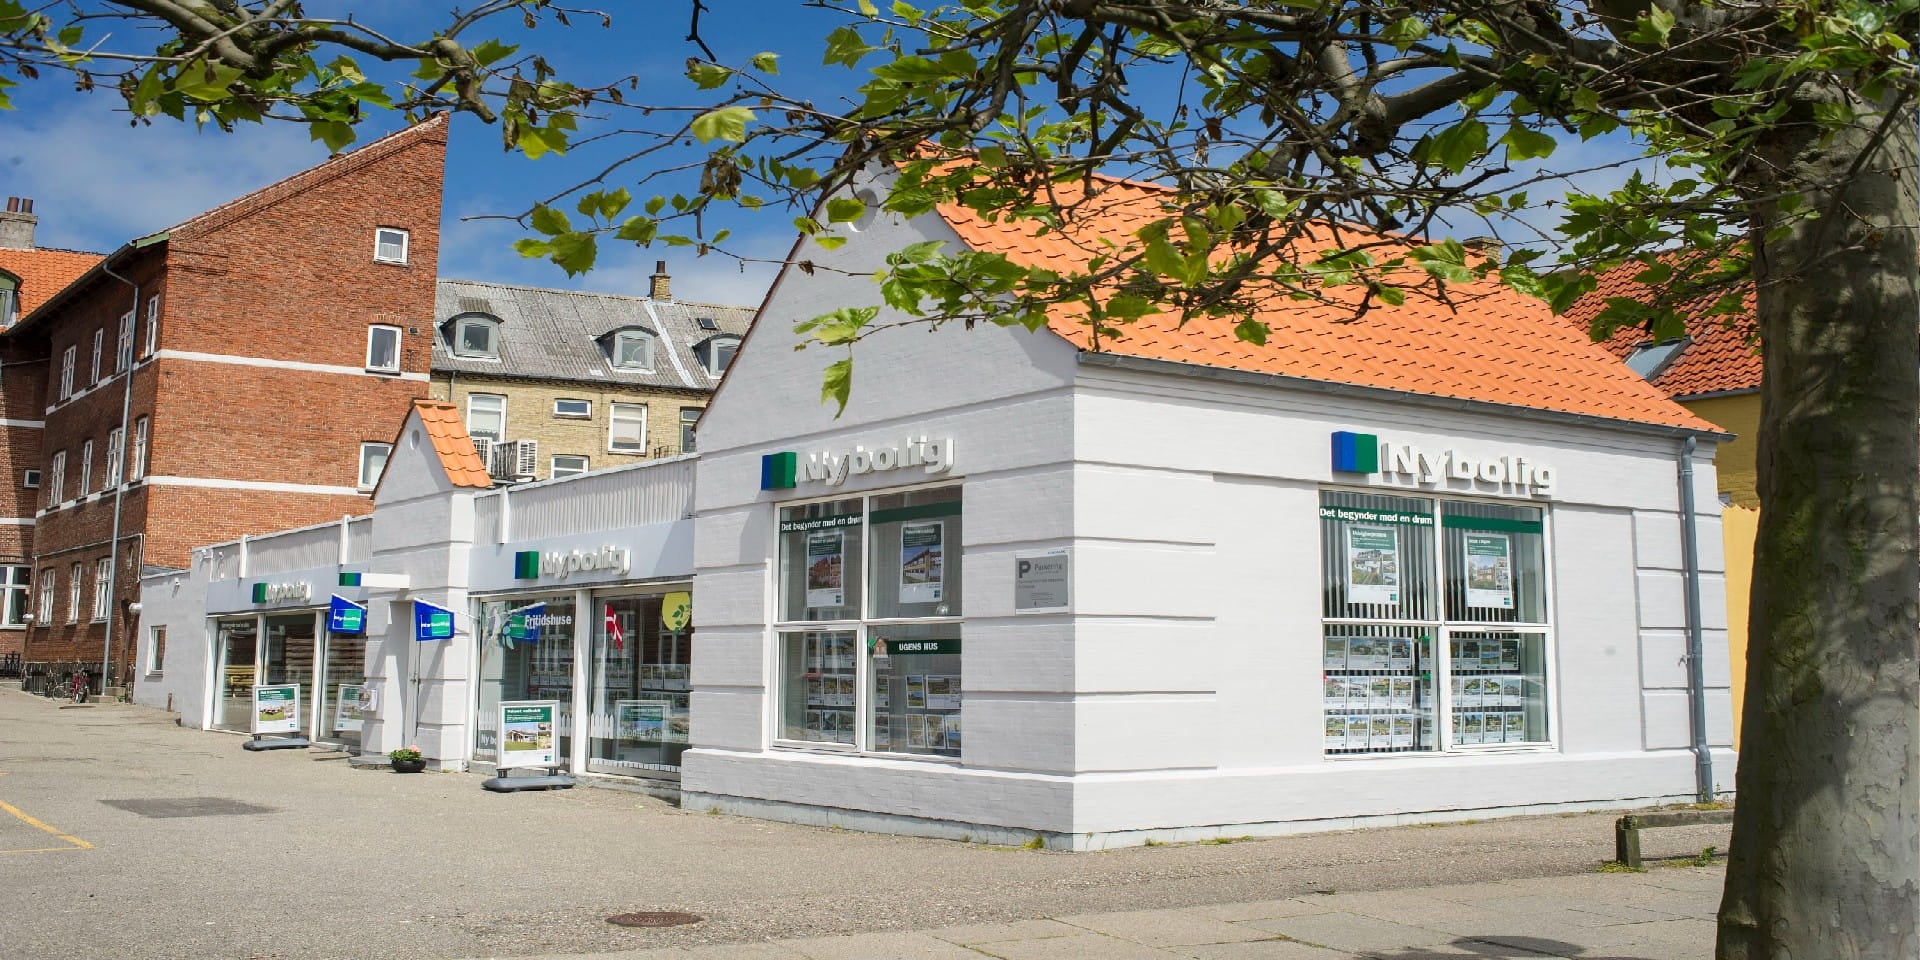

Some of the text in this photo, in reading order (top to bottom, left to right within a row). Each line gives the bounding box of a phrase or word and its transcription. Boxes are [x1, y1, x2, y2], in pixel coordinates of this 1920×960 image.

[795, 435, 954, 487] Nybolig
[1381, 442, 1557, 496] Nybolig
[781, 523, 792, 531] Det
[793, 521, 821, 531] begynder
[822, 517, 836, 527] med
[1319, 508, 1335, 517] Det
[1337, 509, 1378, 521] begynder
[1379, 513, 1398, 522] med
[1400, 515, 1411, 523] en
[541, 544, 632, 579] Nybolig
[1018, 560, 1031, 578] P
[265, 581, 312, 604] Nybolig
[524, 614, 572, 627] Fritidshuse
[898, 642, 938, 651] UGENS HUS
